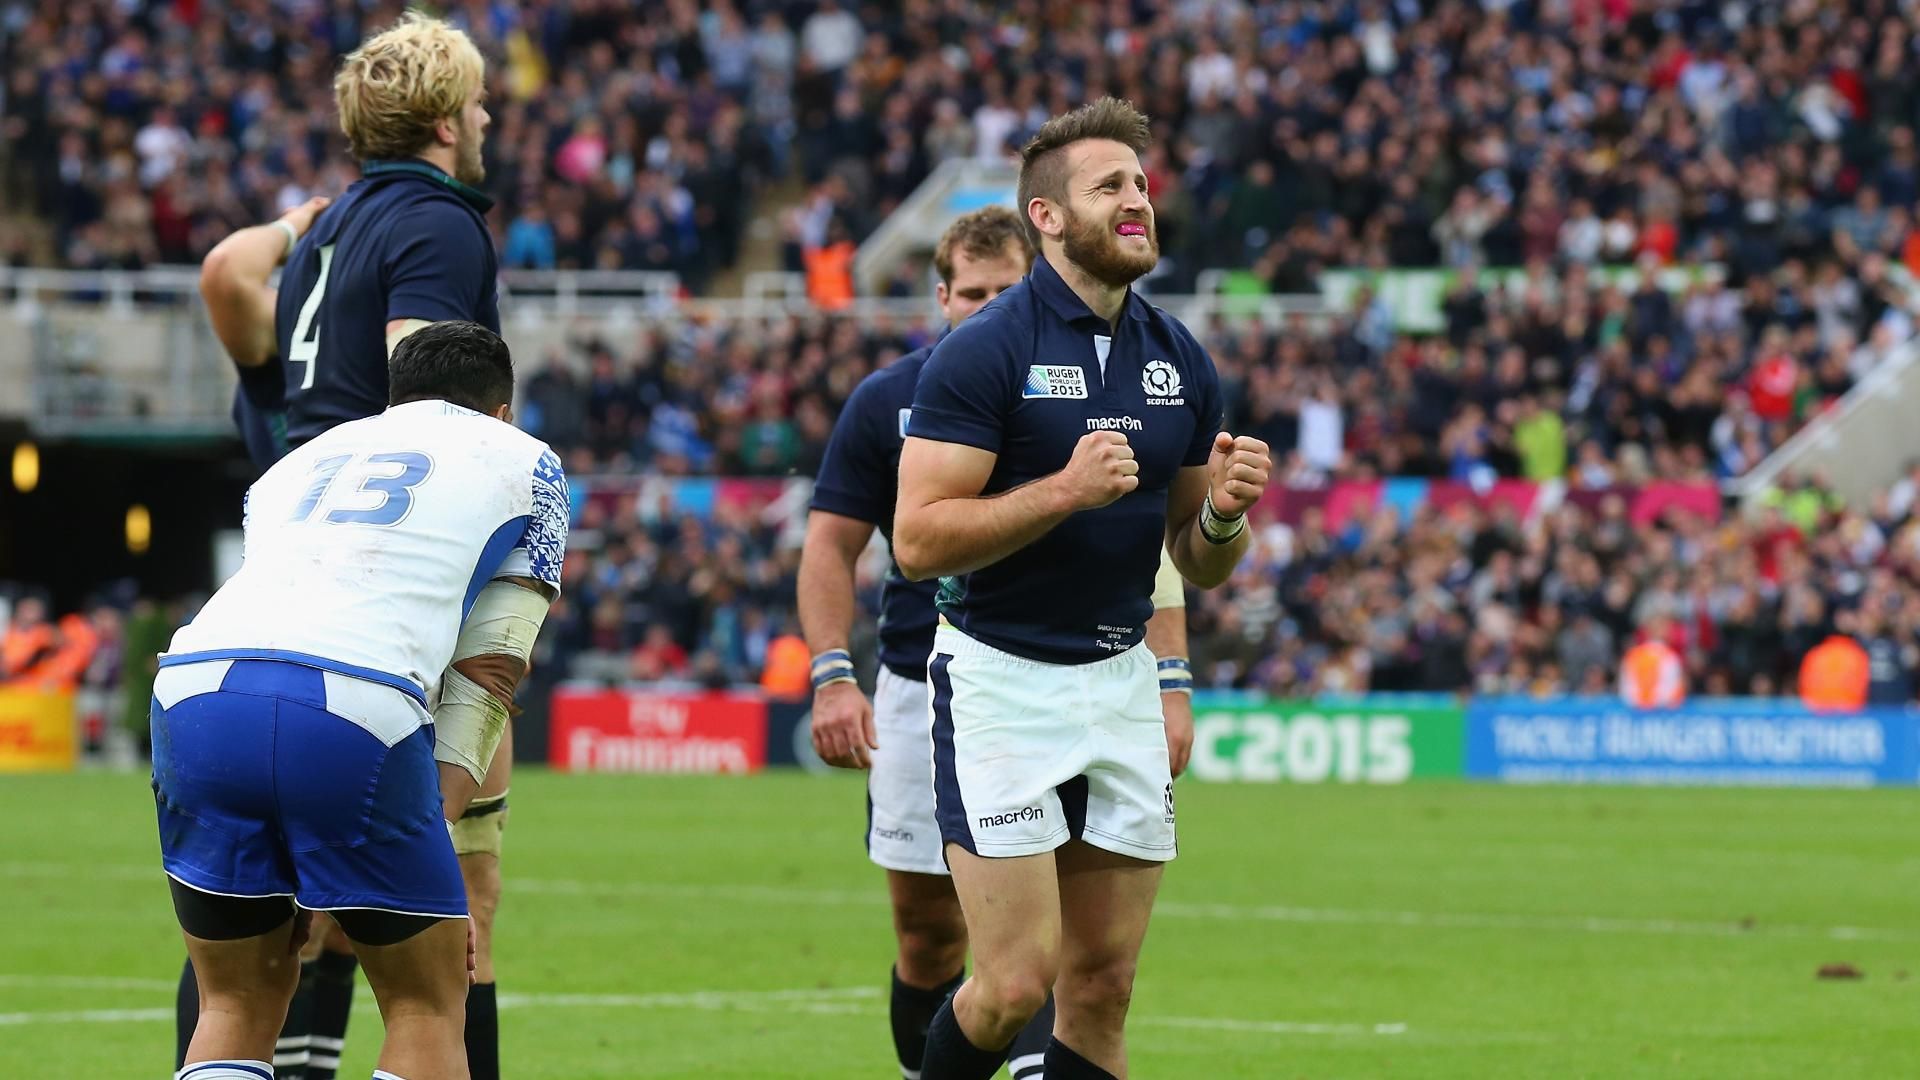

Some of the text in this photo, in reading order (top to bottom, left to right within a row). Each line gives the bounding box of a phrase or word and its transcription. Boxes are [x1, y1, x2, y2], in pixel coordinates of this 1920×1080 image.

[289, 244, 335, 390] 4
[1047, 368, 1080, 379] RUGBY
[1051, 385, 1083, 396] 2015
[1146, 398, 1185, 406] SCOTLAND
[1086, 415, 1143, 431] macron
[286, 451, 435, 527] 13
[979, 806, 1044, 829] macron
